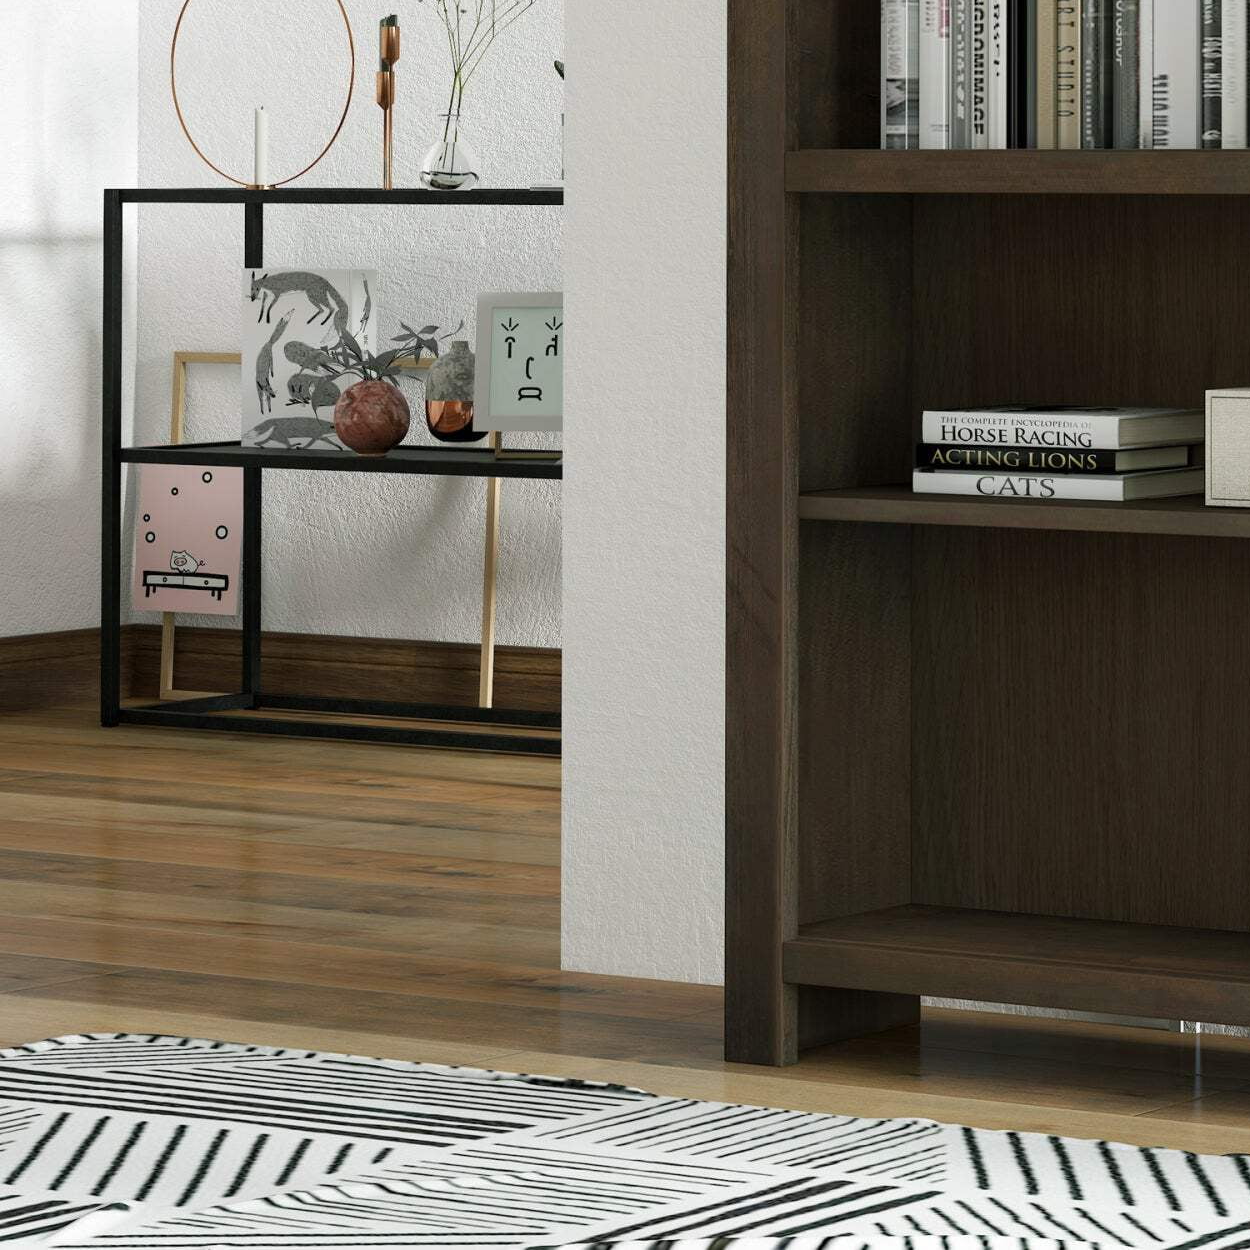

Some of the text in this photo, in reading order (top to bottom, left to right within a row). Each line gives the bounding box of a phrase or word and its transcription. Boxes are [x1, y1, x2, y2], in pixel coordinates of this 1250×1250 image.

[941, 416, 958, 425] THE
[961, 416, 1007, 426] COMPLETE
[1010, 418, 1078, 429] ENCYCLOPEDIA
[940, 424, 1092, 448] HORSE RACING
[931, 448, 1097, 470] ACTING LIONS
[975, 476, 1056, 499] CATS
